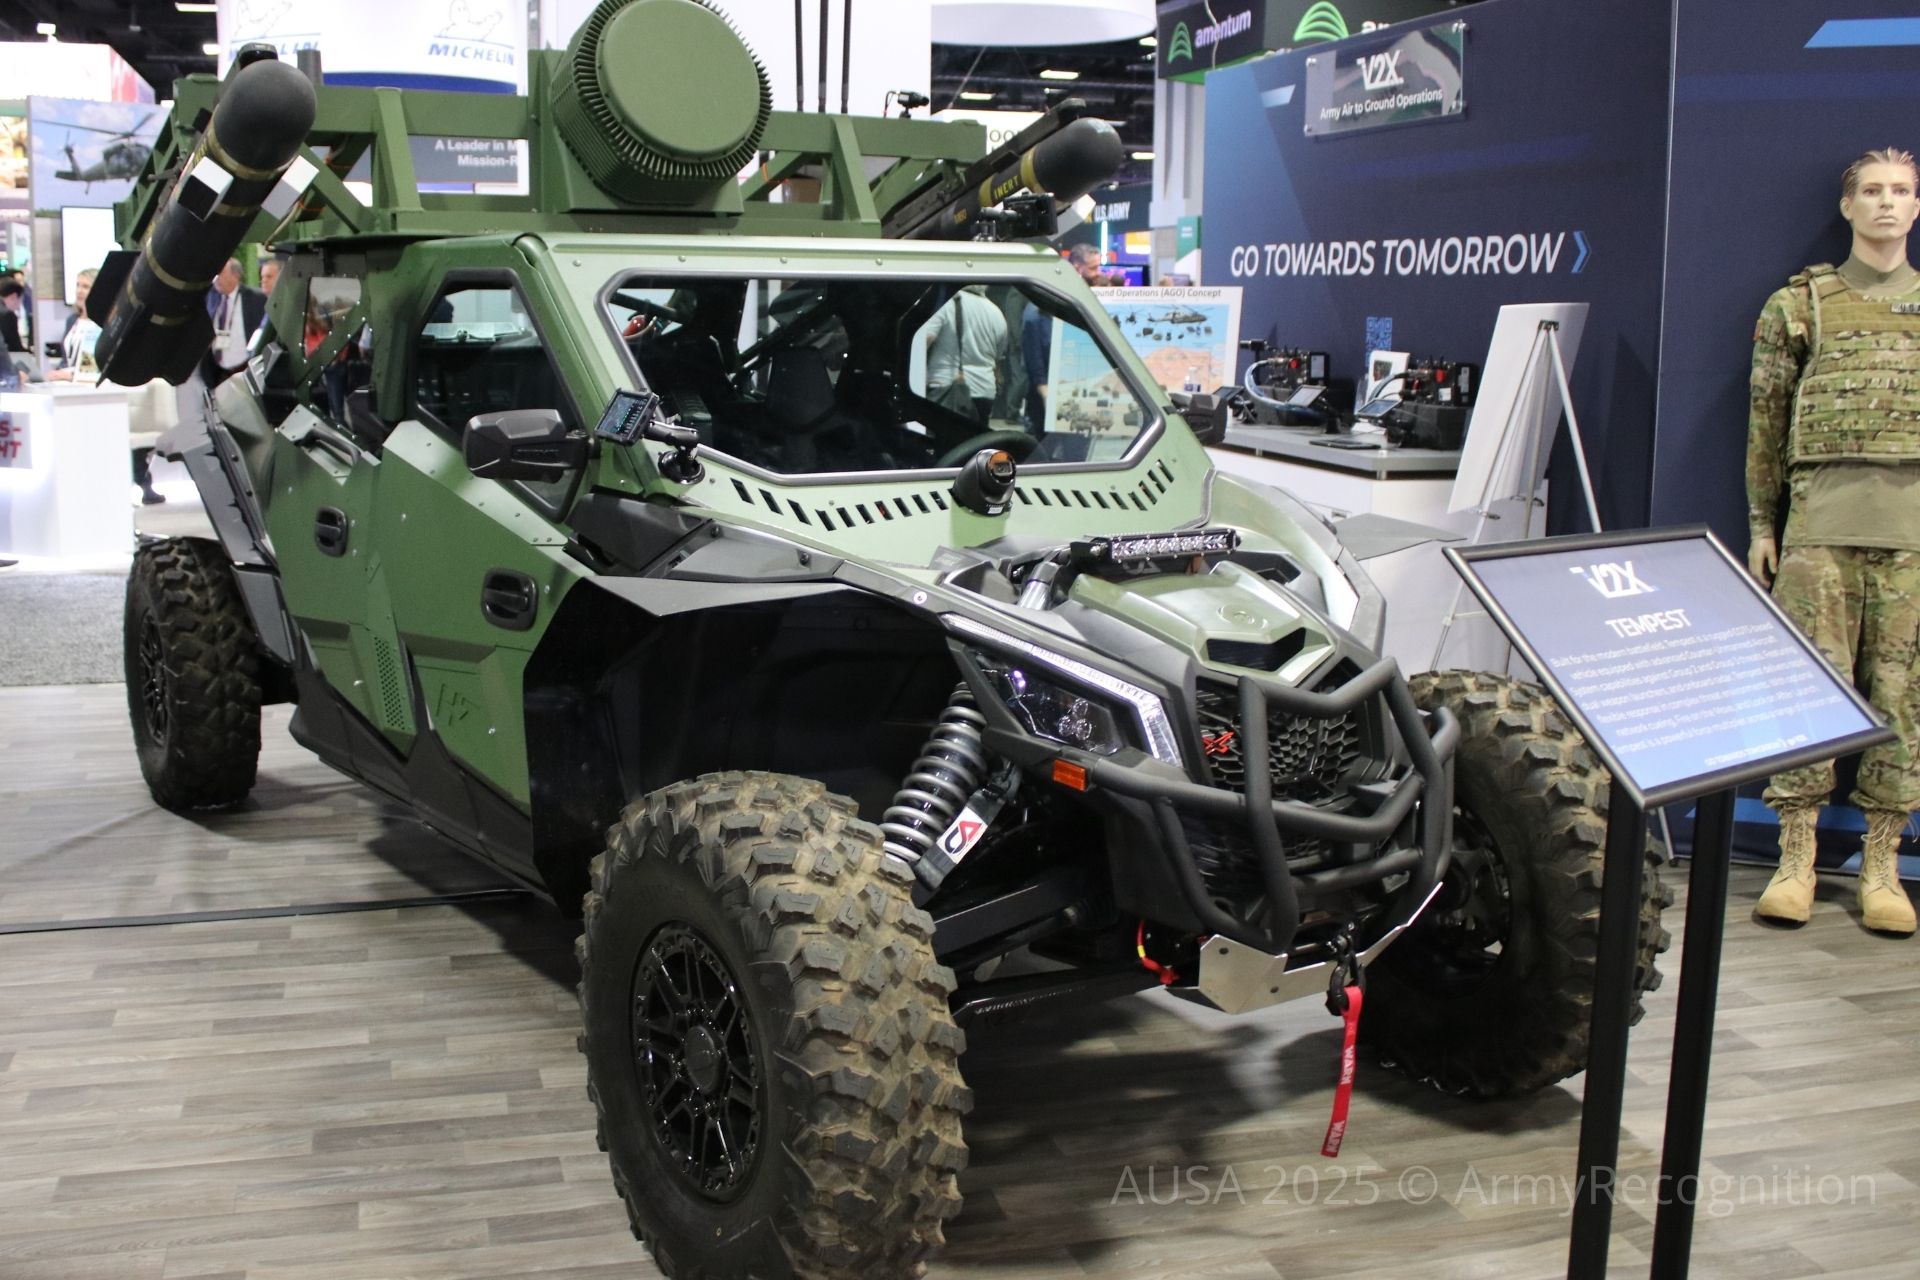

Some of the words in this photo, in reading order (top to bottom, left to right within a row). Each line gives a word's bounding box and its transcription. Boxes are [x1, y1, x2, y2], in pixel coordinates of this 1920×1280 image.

[1195, 10, 1251, 48] amentum
[428, 43, 515, 66] MICHELIN
[1356, 50, 1404, 91] V2X
[1320, 106, 1341, 121] Army
[1342, 103, 1354, 115] Air
[1354, 103, 1363, 114] to
[1364, 95, 1395, 111] Ground
[1397, 88, 1443, 108] Operations
[435, 139, 445, 151] A
[447, 139, 490, 151] Leader
[493, 139, 504, 151] in
[994, 175, 1019, 200] INERT
[1108, 201, 1130, 220] ARMY
[1230, 245, 1259, 277] GO
[1264, 240, 1376, 277] TOWARDS
[1382, 232, 1566, 277] TOMORROW
[1116, 288, 1159, 300] Operations
[1160, 288, 1185, 299] (AGO)
[1187, 288, 1221, 300] Concept
[1569, 560, 1657, 598] V2X
[1604, 607, 1692, 638] TEMPEST
[1340, 1045, 1355, 1085] WARN
